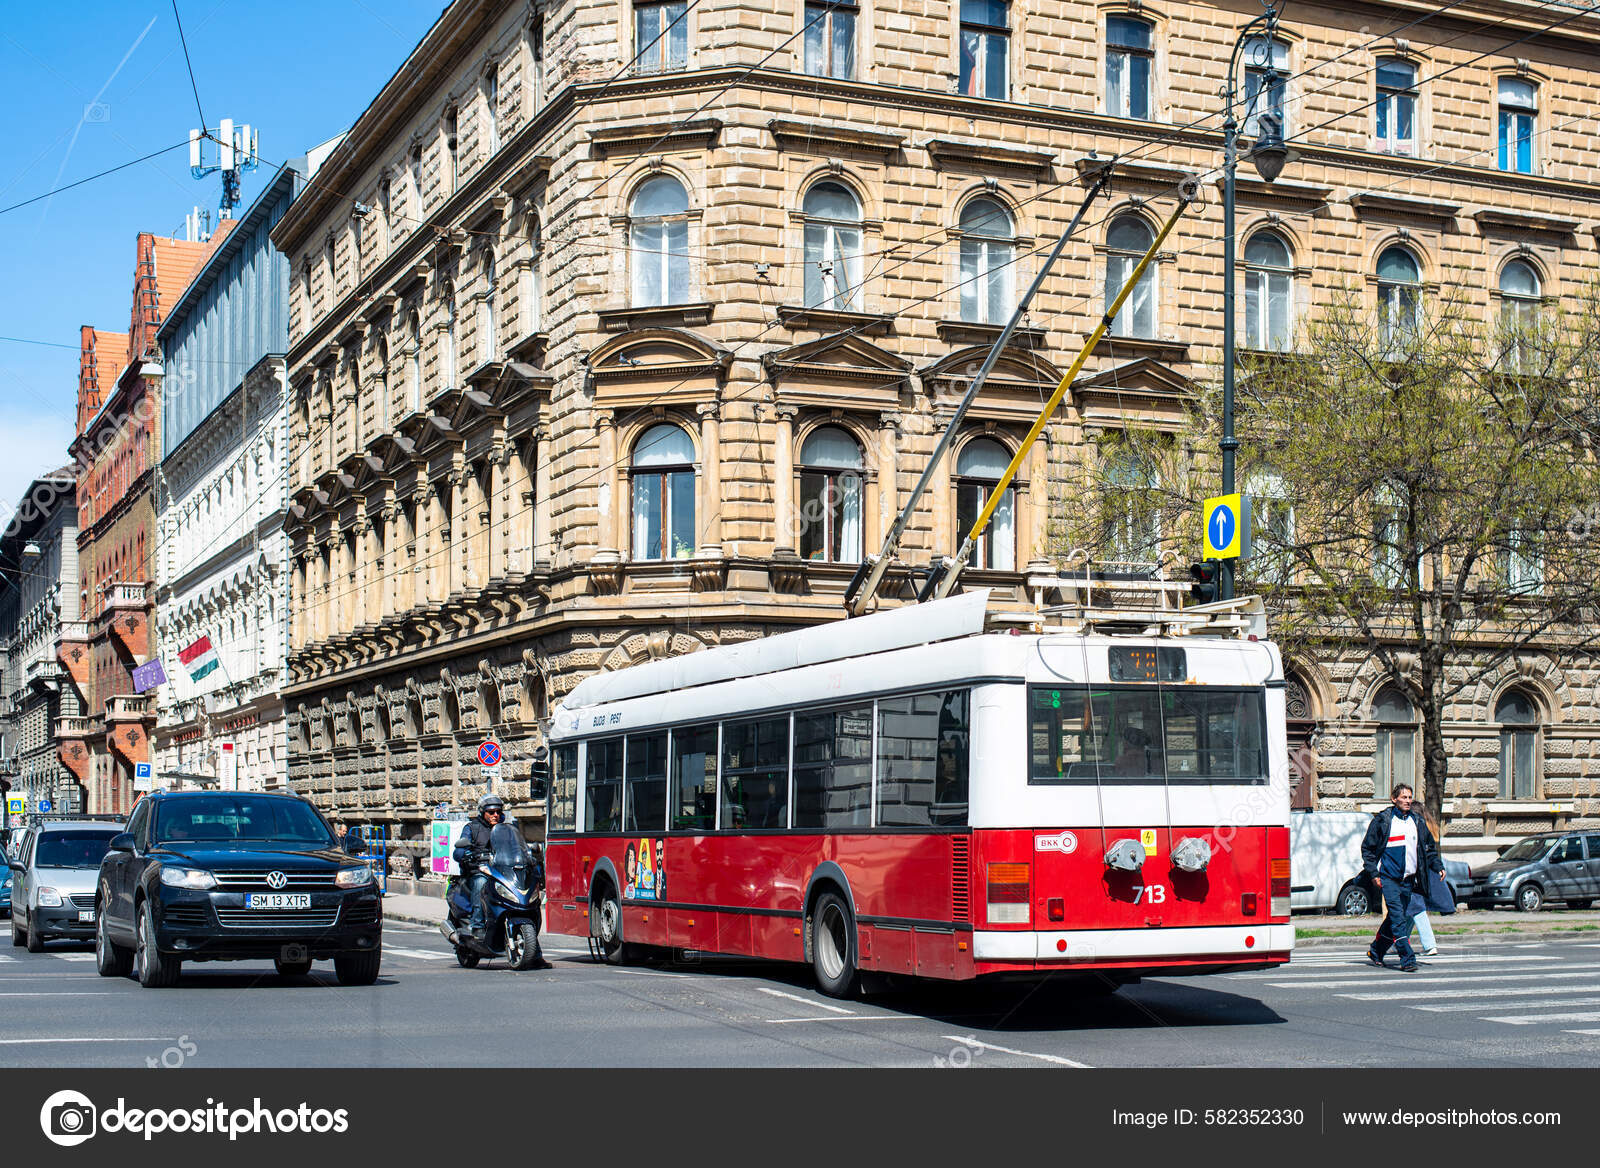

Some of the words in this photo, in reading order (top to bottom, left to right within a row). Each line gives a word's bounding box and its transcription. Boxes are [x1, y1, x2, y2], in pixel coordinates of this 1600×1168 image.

[1041, 839, 1058, 847] BKK
[1131, 884, 1166, 904] 713
[252, 895, 268, 906] SM
[272, 895, 282, 906] 13
[286, 895, 308, 906] XTR
